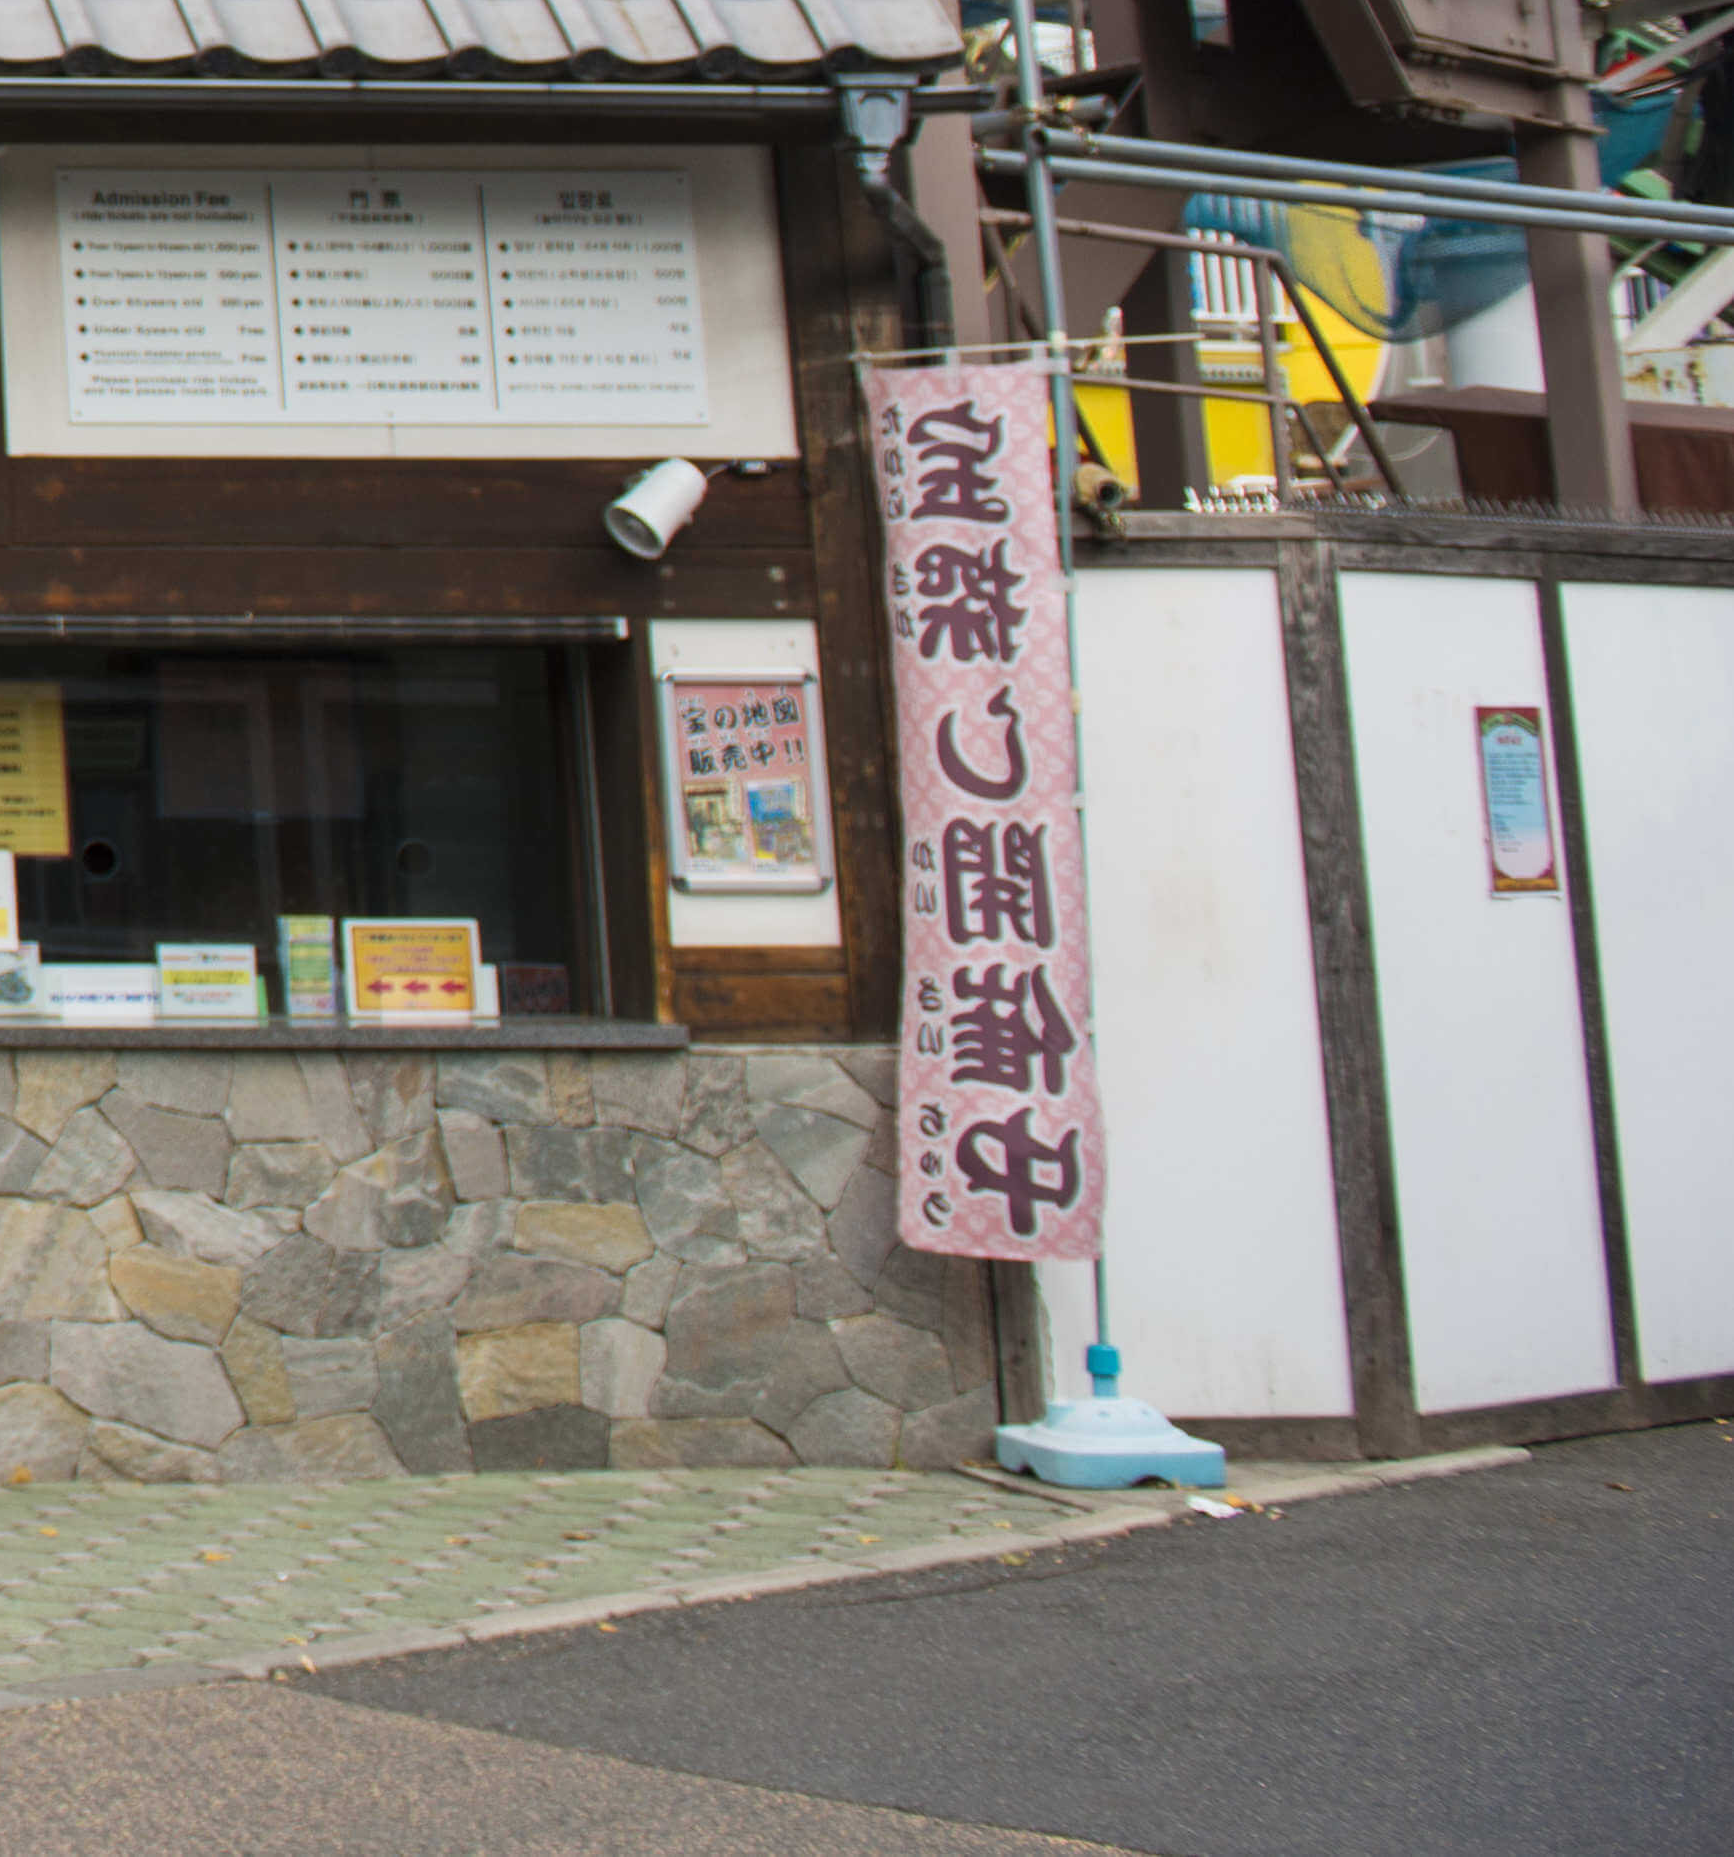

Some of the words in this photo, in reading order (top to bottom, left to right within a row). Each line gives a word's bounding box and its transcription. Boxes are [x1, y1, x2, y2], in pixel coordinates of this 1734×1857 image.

[93, 190, 190, 207] Admission
[682, 695, 800, 735] 宝の地図
